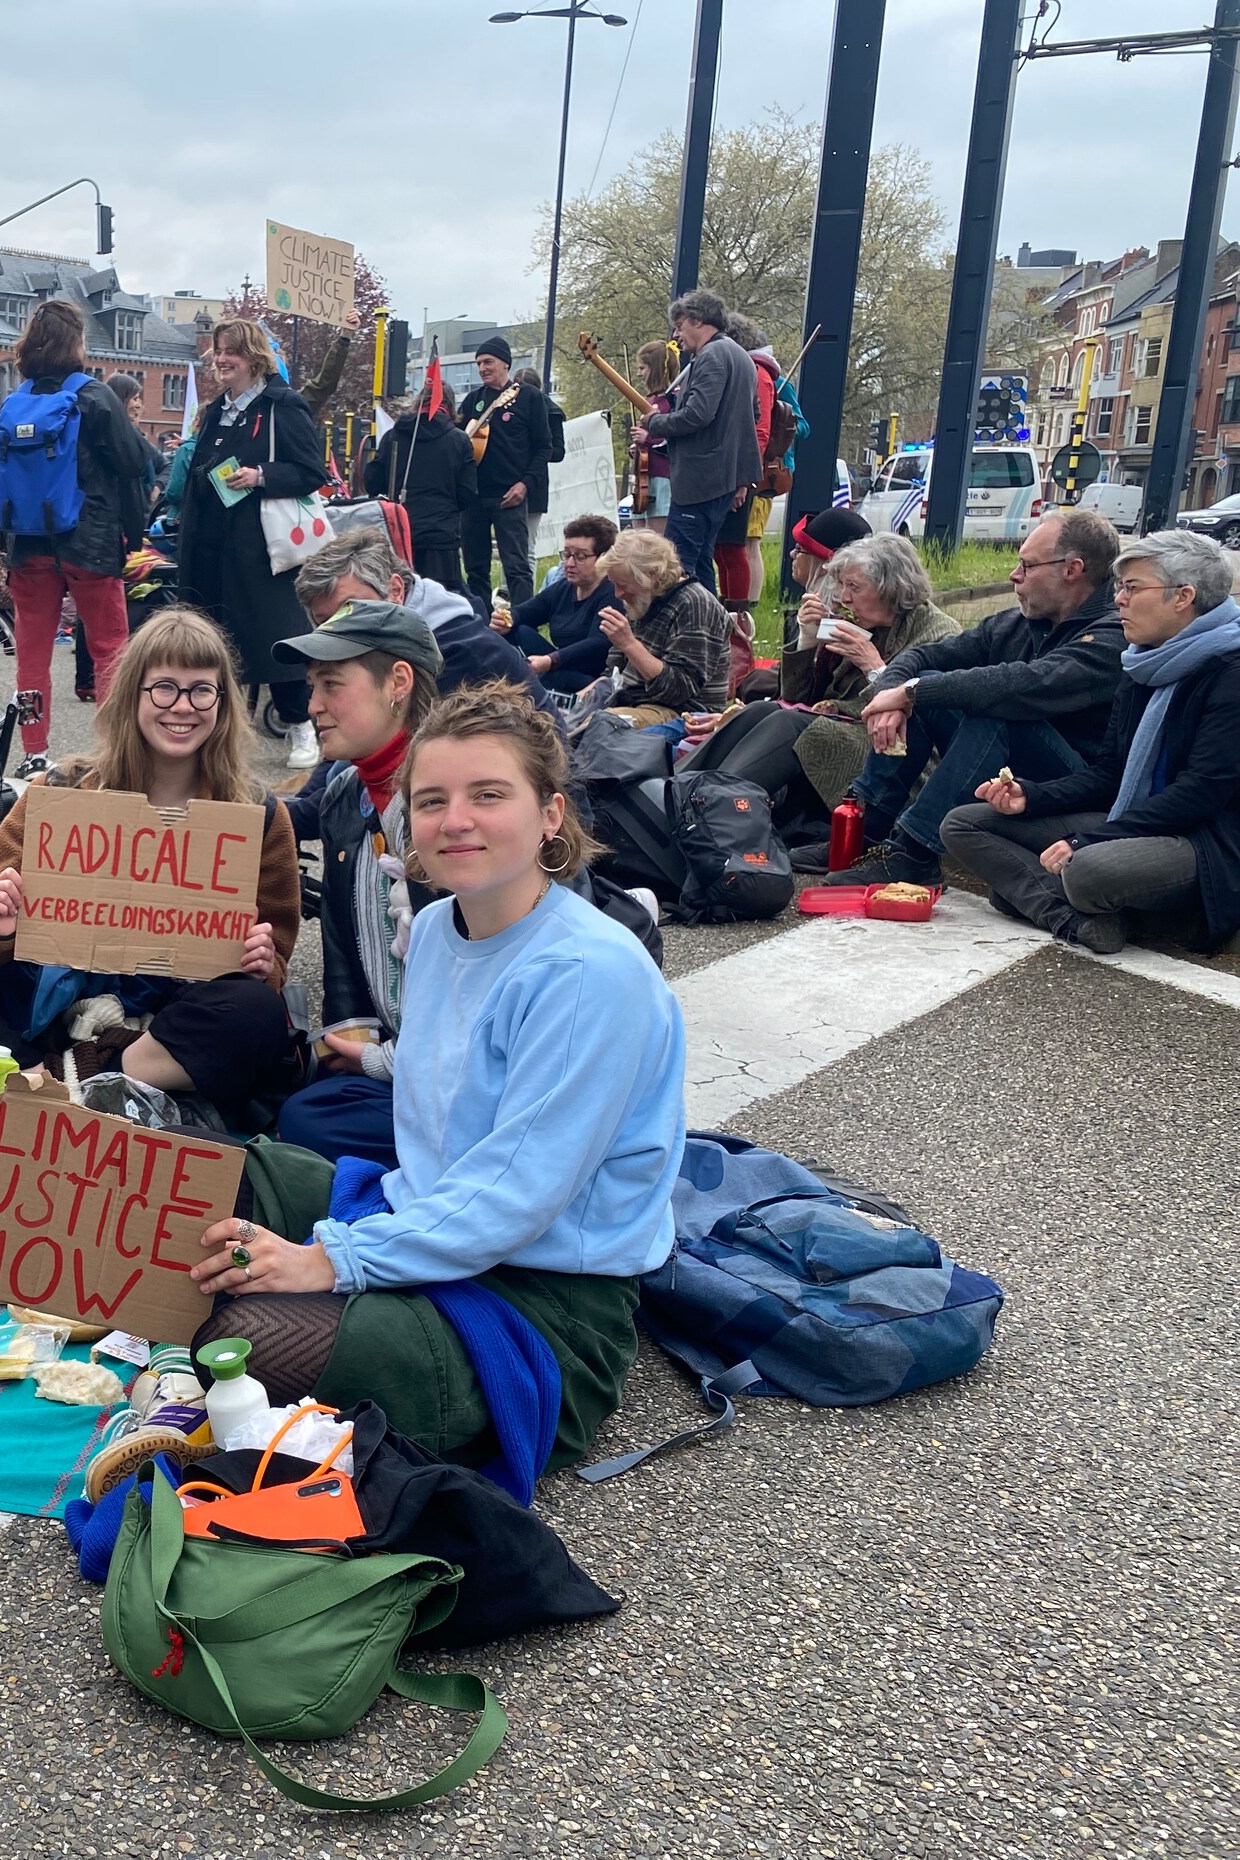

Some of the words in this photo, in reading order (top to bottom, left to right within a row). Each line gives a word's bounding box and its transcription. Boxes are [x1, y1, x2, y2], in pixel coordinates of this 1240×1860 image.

[280, 236, 351, 278] CLIMATE
[280, 262, 344, 302] JUSTICE
[37, 821, 248, 895] RADICALE
[23, 895, 255, 942] VERBEELDINGSKRACHT
